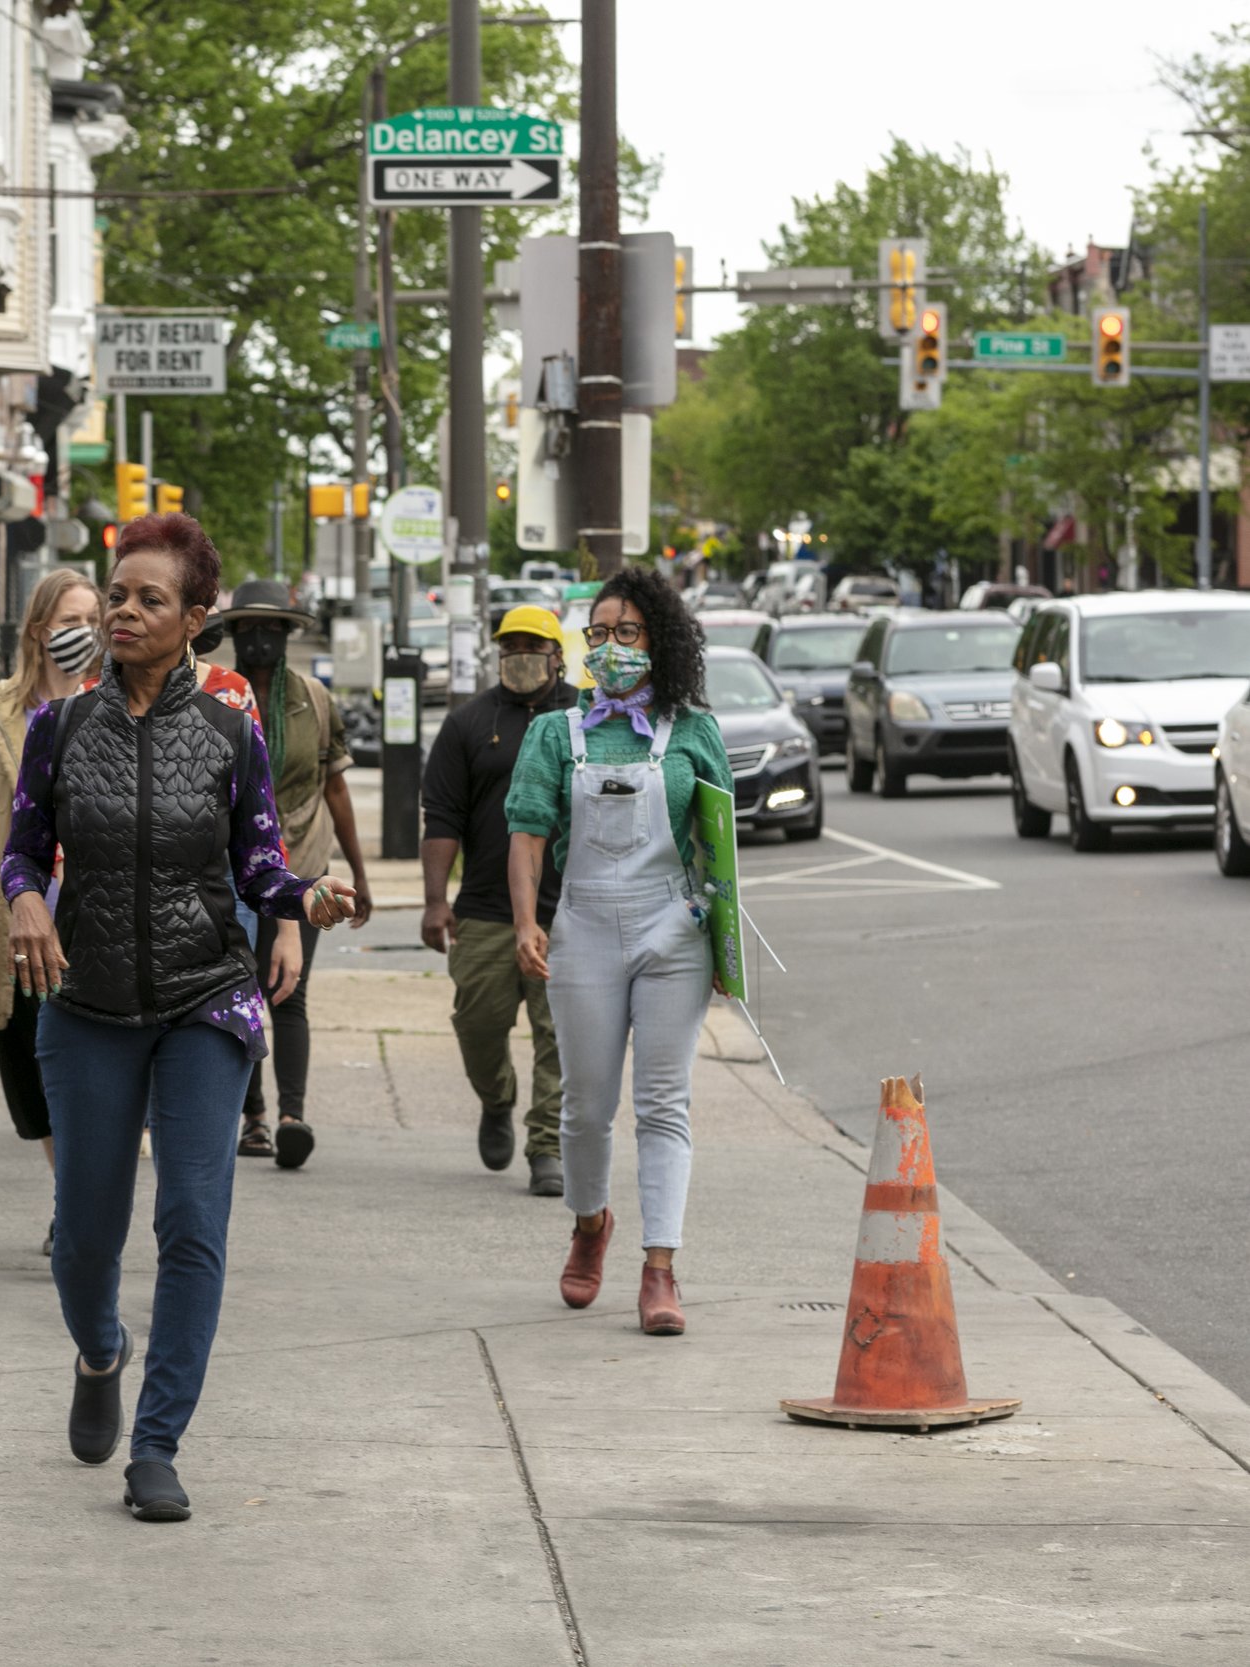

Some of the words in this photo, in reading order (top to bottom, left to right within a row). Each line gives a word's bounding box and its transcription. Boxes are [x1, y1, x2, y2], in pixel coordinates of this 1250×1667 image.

[373, 123, 517, 155] Delancey
[529, 125, 559, 152] St
[395, 170, 445, 189] ONE
[452, 170, 506, 188] WAY
[115, 349, 150, 371] FOR
[156, 349, 204, 371] RENT
